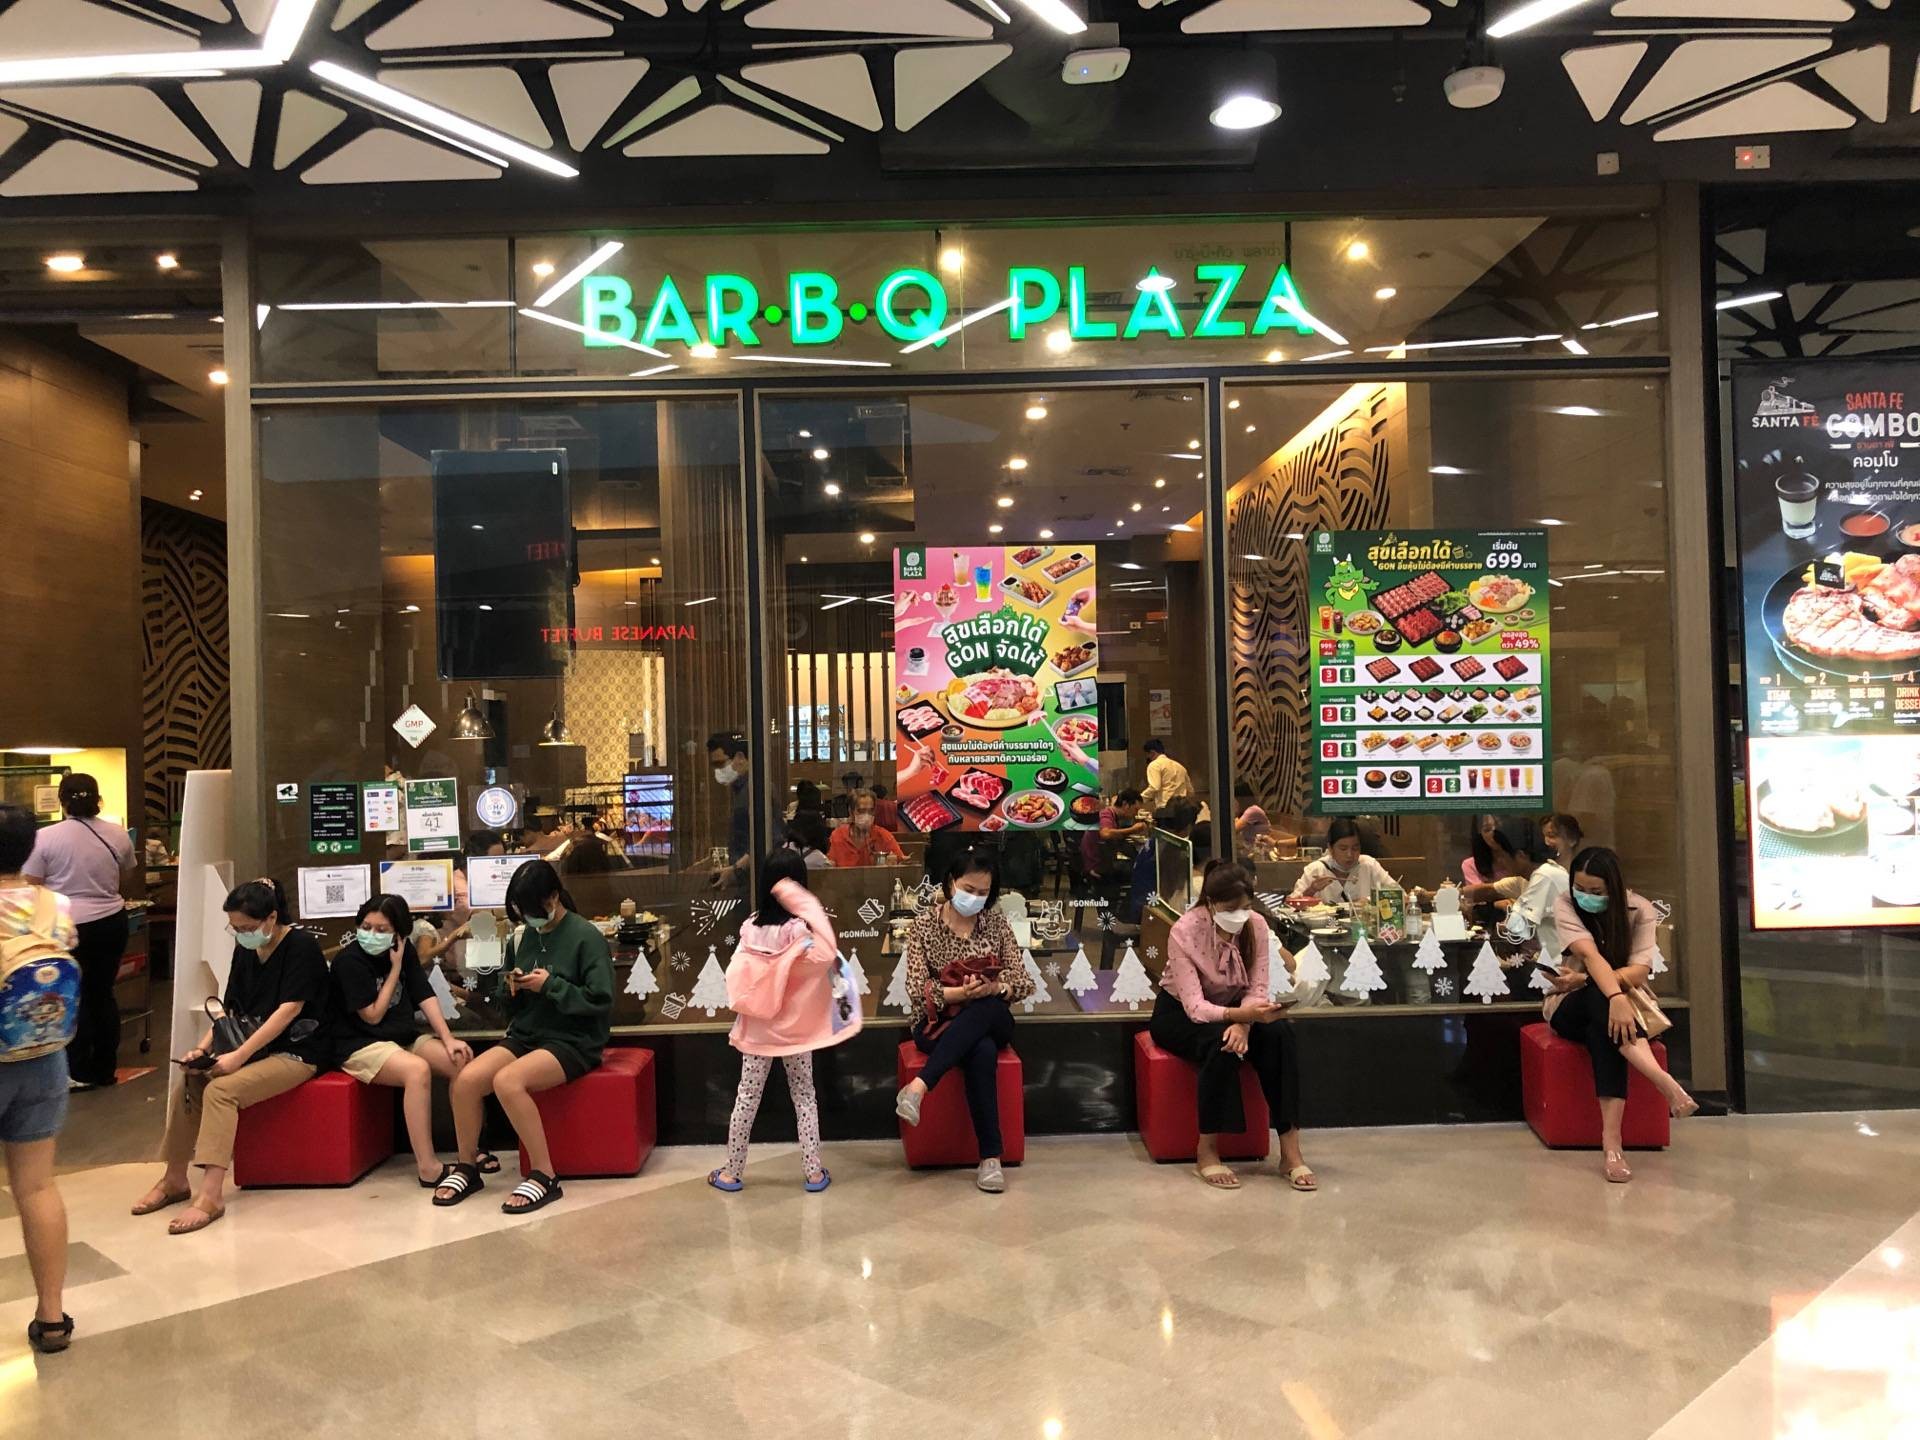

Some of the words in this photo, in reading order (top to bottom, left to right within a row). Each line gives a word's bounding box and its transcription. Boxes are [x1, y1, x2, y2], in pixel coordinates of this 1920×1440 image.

[1009, 264, 1315, 342] PLAZA
[1845, 392, 1886, 410] SANTA
[1752, 416, 1800, 428] SANTA
[1853, 450, 1899, 468] คอมโบ
[1486, 553, 1522, 568] 699
[1378, 562, 1396, 570] GON
[943, 612, 1049, 648] สุขเลือกได้
[1515, 639, 1539, 648] 49%
[947, 641, 989, 668] GON
[996, 638, 1046, 668] จัดให้
[1326, 669, 1332, 678] 3
[1344, 669, 1351, 678] 1
[1907, 670, 1915, 683] 4
[1819, 672, 1827, 685] 2
[1327, 709, 1333, 717] 3
[1344, 708, 1352, 717] 2
[405, 720, 424, 728] GMP
[1327, 744, 1334, 753] 2
[1345, 744, 1352, 753] 1
[1328, 781, 1334, 789] 2
[1346, 780, 1352, 789] 2
[1431, 780, 1438, 788] 2
[1449, 780, 1456, 788] 2
[425, 816, 441, 829] 41
